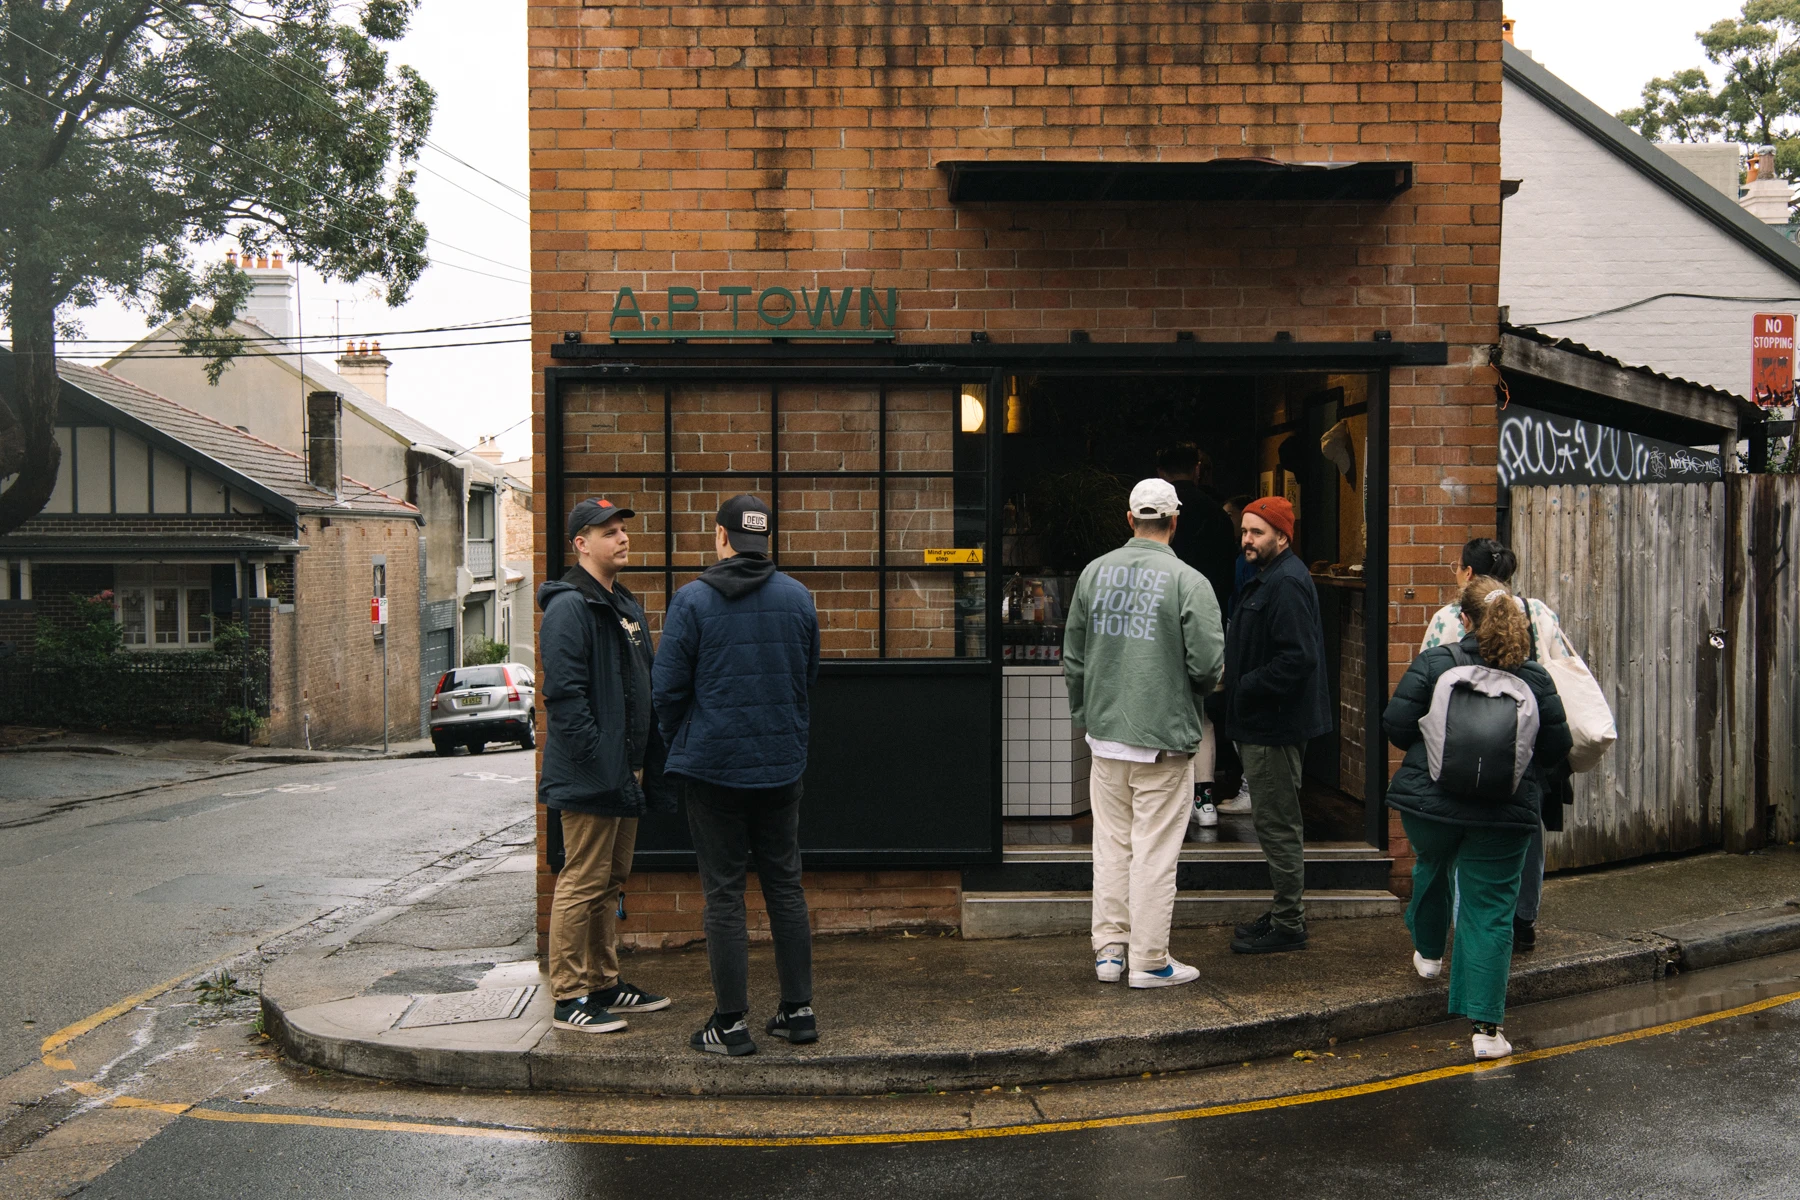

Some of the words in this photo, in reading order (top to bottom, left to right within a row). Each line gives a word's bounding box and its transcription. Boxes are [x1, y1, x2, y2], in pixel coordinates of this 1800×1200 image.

[609, 286, 699, 328] A.P
[718, 286, 897, 328] TOWN
[1765, 319, 1782, 333] NO
[1753, 336, 1793, 349] STOPPING
[747, 516, 764, 525] DEUS
[1096, 565, 1170, 592] HOUSE
[1092, 588, 1165, 616] HOUSE
[1092, 612, 1158, 641] HOUSE
